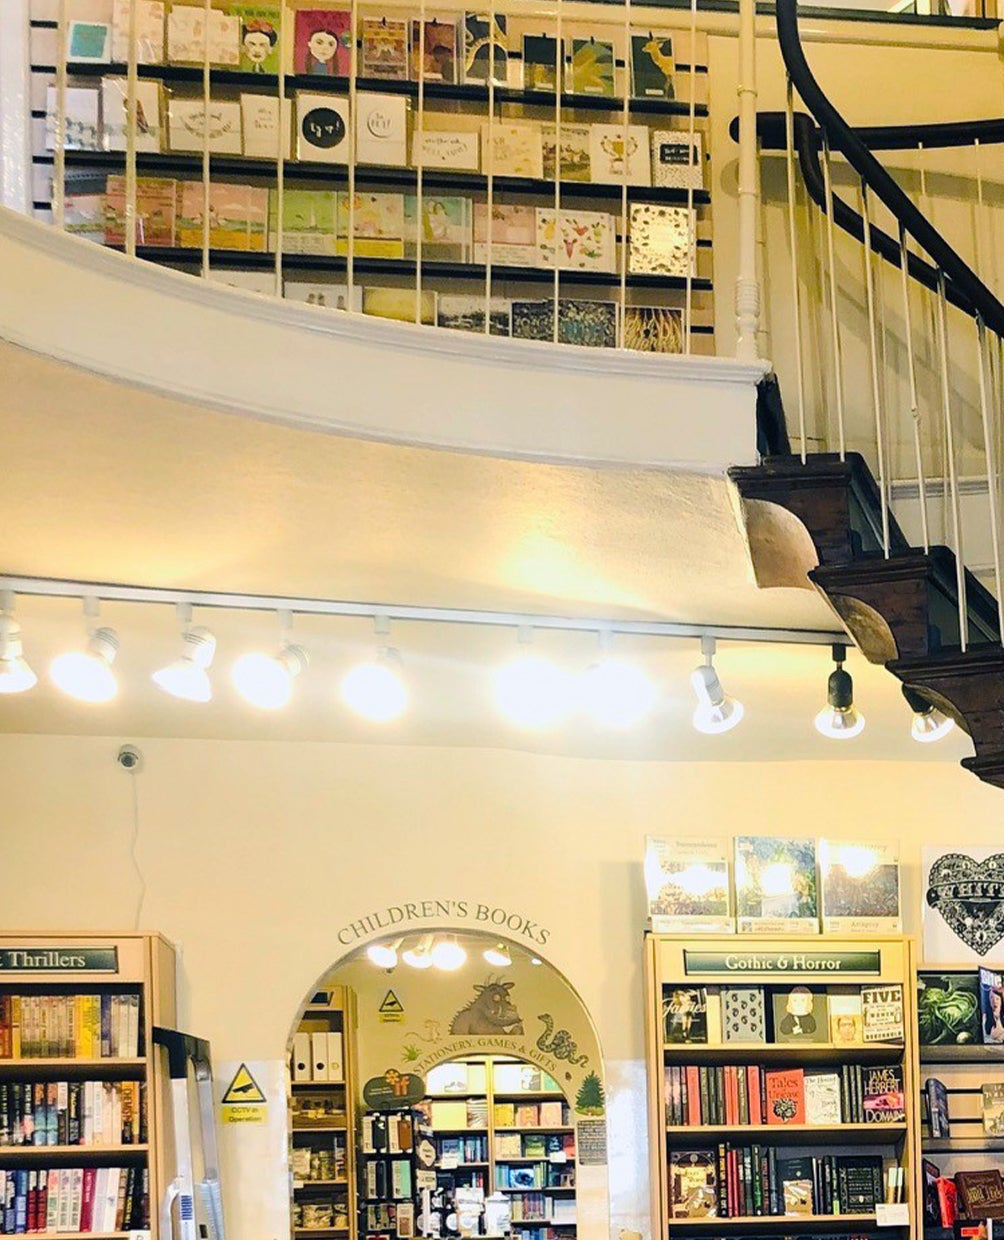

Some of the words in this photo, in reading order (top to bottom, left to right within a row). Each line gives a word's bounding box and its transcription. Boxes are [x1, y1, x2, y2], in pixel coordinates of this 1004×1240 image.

[337, 900, 468, 946] CHILDREN'S
[475, 904, 551, 946] BOOKS
[8, 951, 86, 968] Thrillers
[725, 954, 773, 971] Gothic
[776, 954, 788, 970] &
[791, 954, 842, 971] Horror
[863, 990, 901, 1004] FIVE
[477, 1038, 518, 1051] GAMES
[529, 1048, 558, 1074] GIFTS
